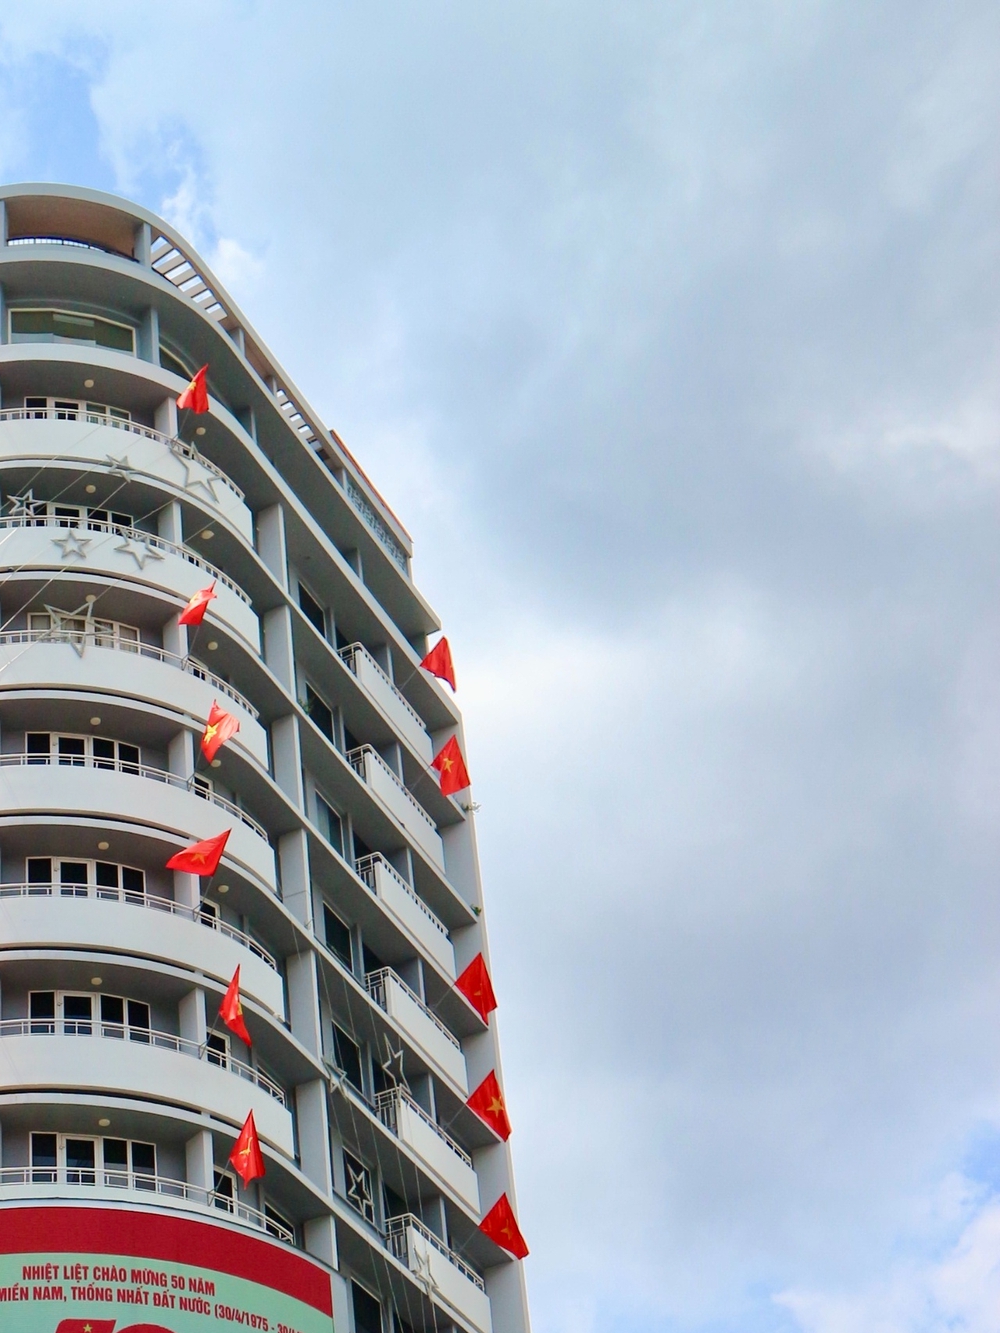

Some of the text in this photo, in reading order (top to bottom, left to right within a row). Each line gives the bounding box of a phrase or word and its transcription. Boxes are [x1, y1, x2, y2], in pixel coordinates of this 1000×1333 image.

[22, 1263, 215, 1297] NHIỆT LIỆT CHÀO MỪNG 50 NĂM
[33, 1286, 67, 1302] NAM,
[71, 1282, 113, 1302] THỐNG
[117, 1286, 149, 1306] NHẤT
[153, 1289, 175, 1310] ĐẤT
[179, 1296, 211, 1315] NƯỚC
[215, 1304, 269, 1332] (30/4/1975
